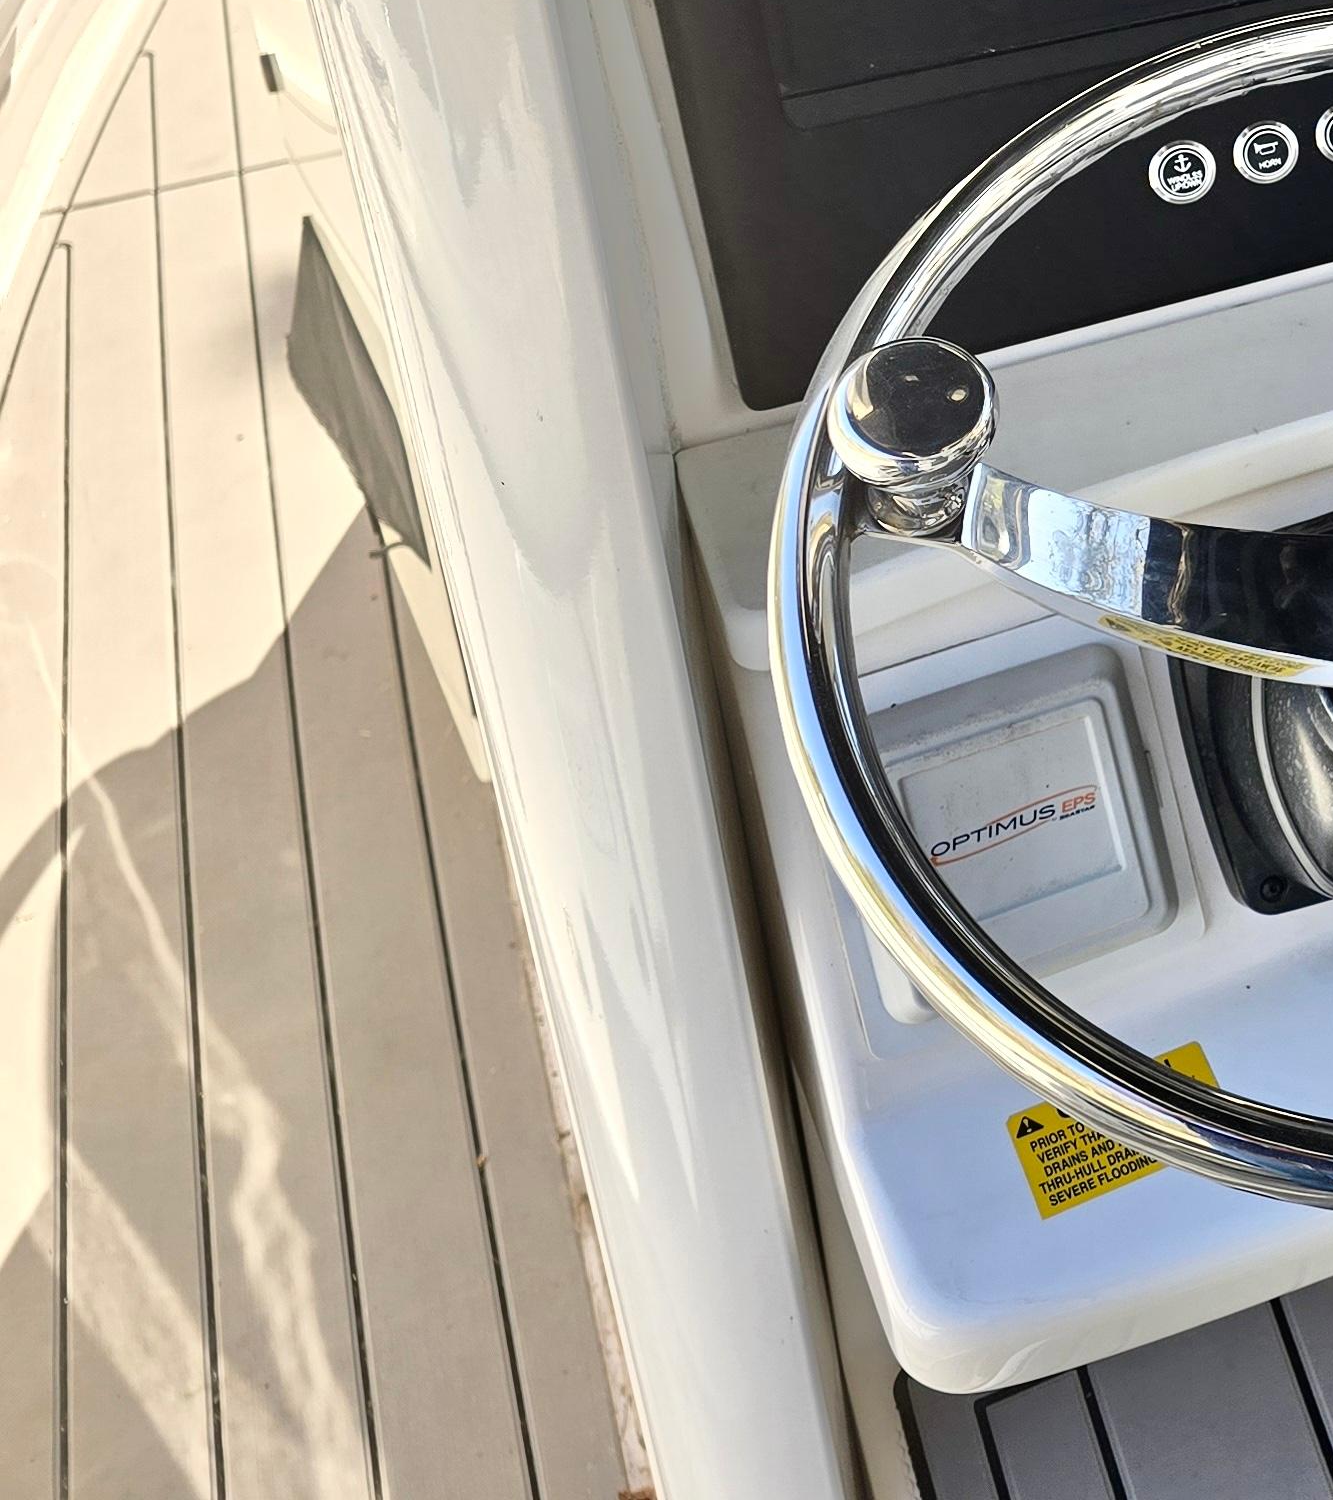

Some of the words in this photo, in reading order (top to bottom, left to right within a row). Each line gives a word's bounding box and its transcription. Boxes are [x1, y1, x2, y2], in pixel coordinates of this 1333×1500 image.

[1259, 158, 1282, 169] HORN
[931, 804, 1056, 857] OPTIMUS
[1061, 792, 1096, 813] EPS
[1030, 1129, 1067, 1152] PRIOR
[1068, 1122, 1085, 1136] TO
[1037, 1140, 1078, 1163] VERIFY
[1080, 1129, 1106, 1145] THA
[1044, 1150, 1089, 1177] DRAINS
[1091, 1139, 1115, 1158] AND
[1039, 1160, 1106, 1194] THRU-HULL
[1048, 1180, 1097, 1206] SEVERE
